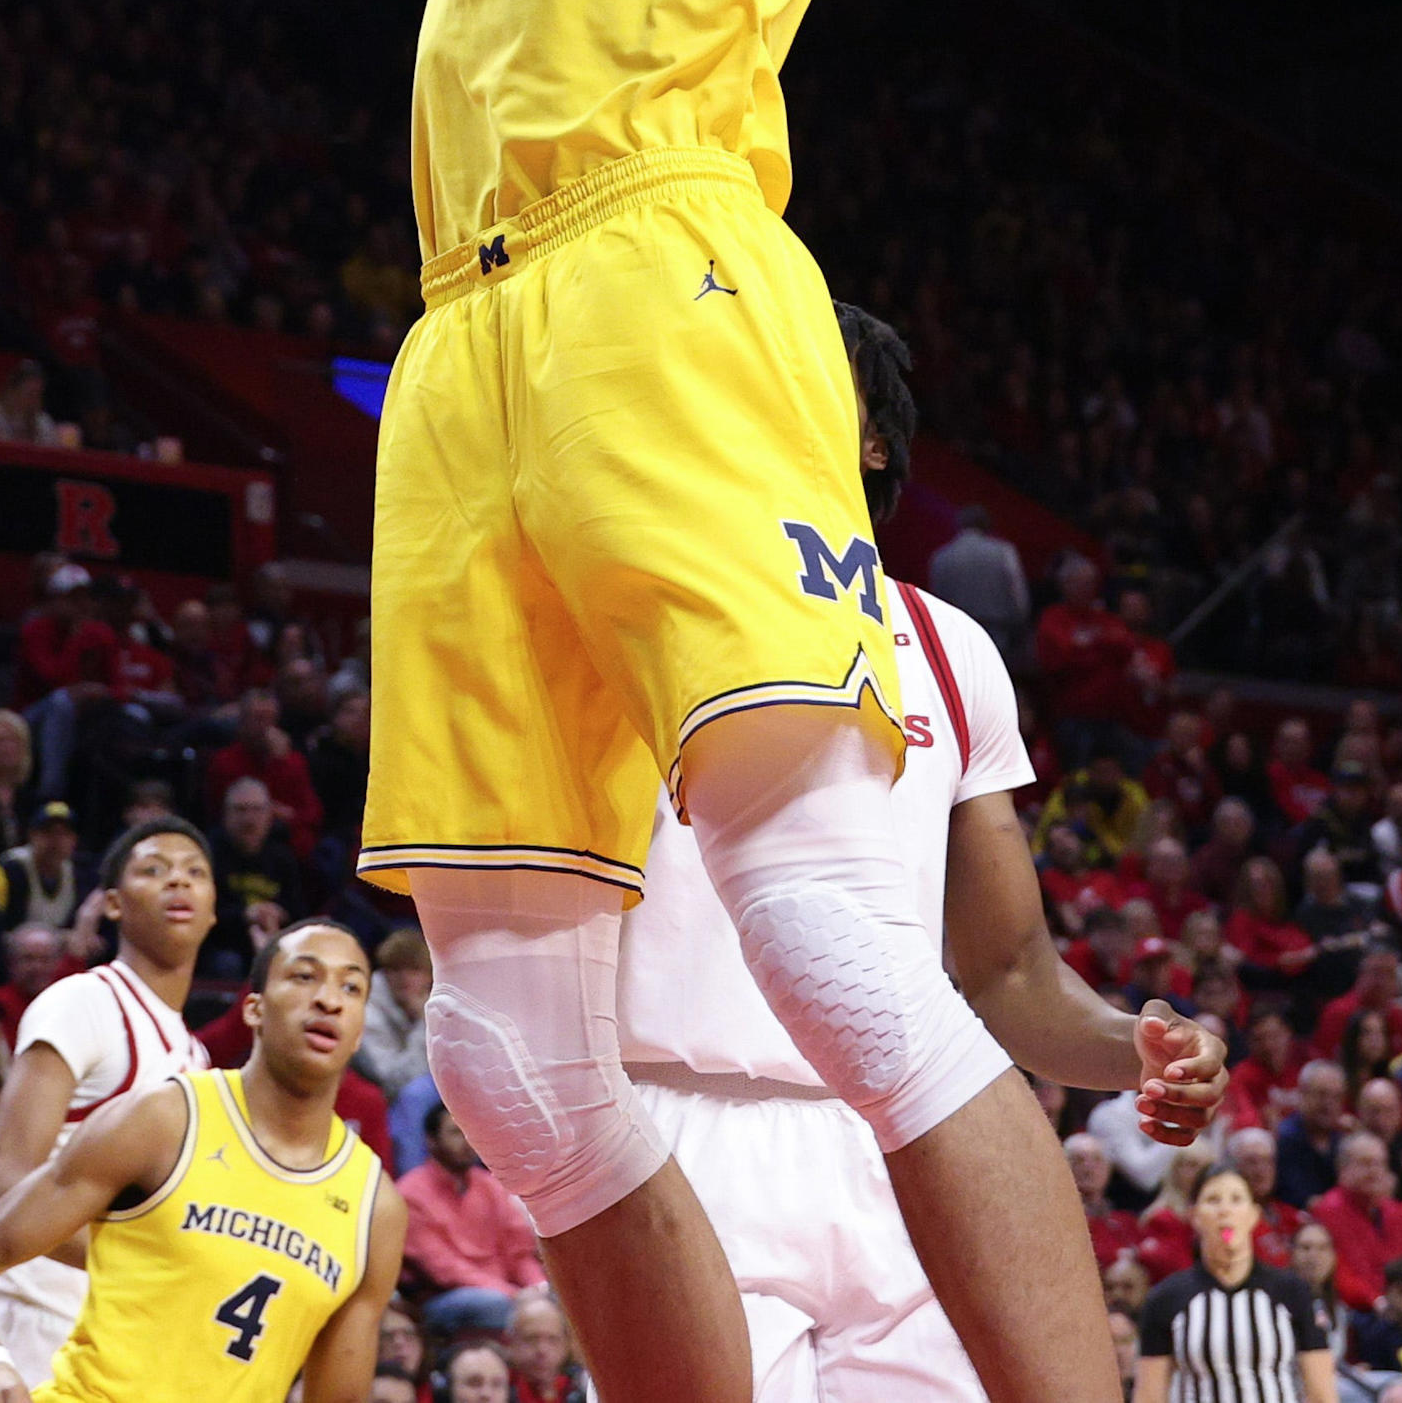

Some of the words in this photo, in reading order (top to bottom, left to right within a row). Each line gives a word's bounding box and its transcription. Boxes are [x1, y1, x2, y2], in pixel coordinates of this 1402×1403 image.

[478, 233, 510, 276] M
[54, 478, 122, 562] R
[778, 518, 886, 627] M
[180, 1202, 343, 1293] MICHIGAN
[213, 1272, 286, 1364] 4
